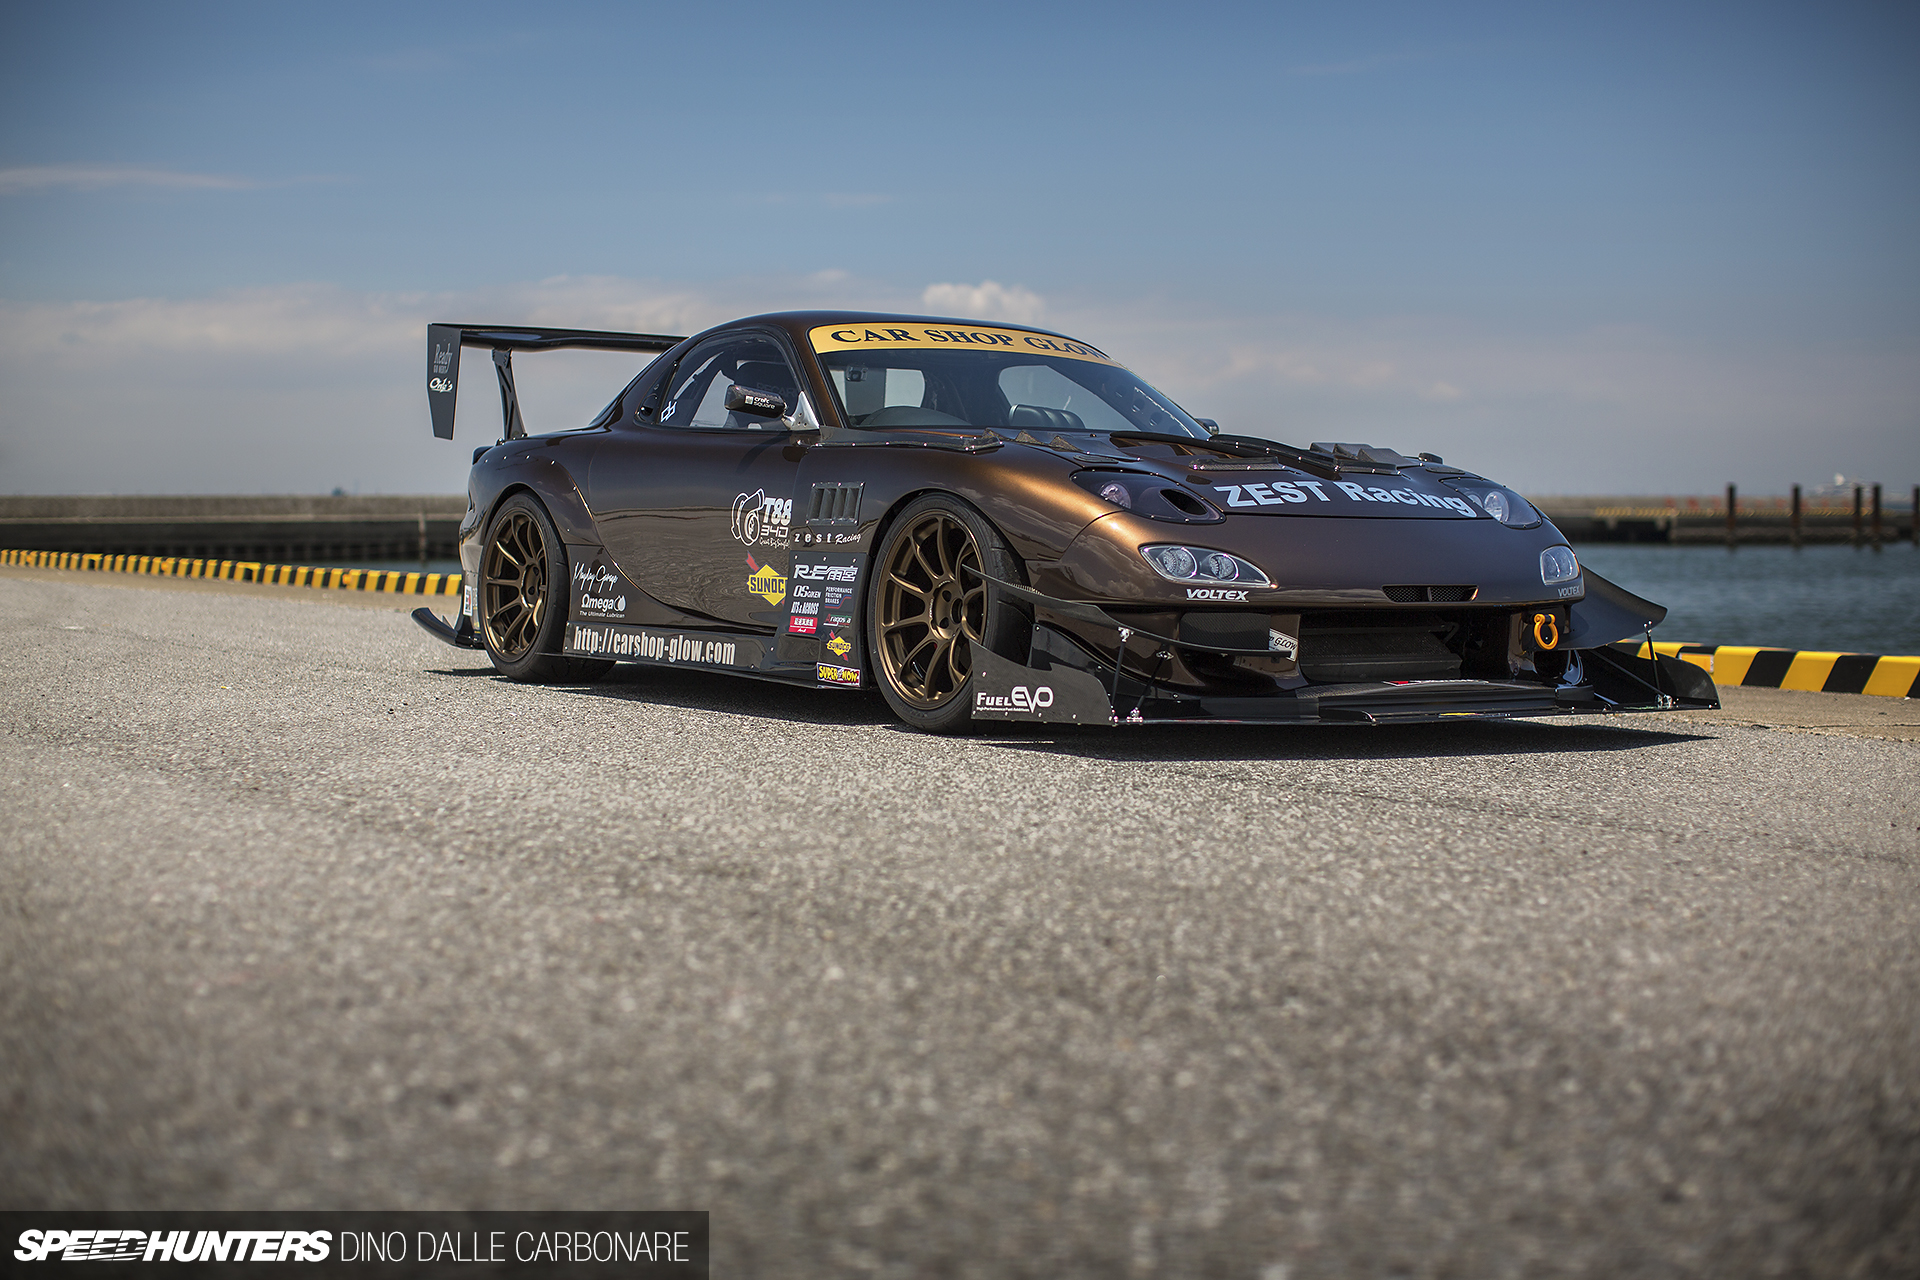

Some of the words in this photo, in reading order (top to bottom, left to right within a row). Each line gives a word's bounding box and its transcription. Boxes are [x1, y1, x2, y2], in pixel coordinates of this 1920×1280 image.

[830, 328, 921, 343] CAR
[923, 328, 1014, 347] SHOP
[1023, 337, 1108, 361] GLOW
[1213, 480, 1331, 508] ZEST
[1333, 481, 1478, 518] Racing
[763, 497, 793, 526] T88
[794, 533, 831, 544] zest
[835, 533, 861, 545] Racing
[750, 576, 788, 594] SUNOC
[1558, 586, 1580, 597] VOLTEX
[1186, 588, 1249, 601] VOLTEX
[825, 613, 851, 624] Aragosa
[573, 626, 736, 665] http://carshop-glow.com
[828, 641, 851, 652] SUNOCO
[818, 665, 838, 680] SUPER
